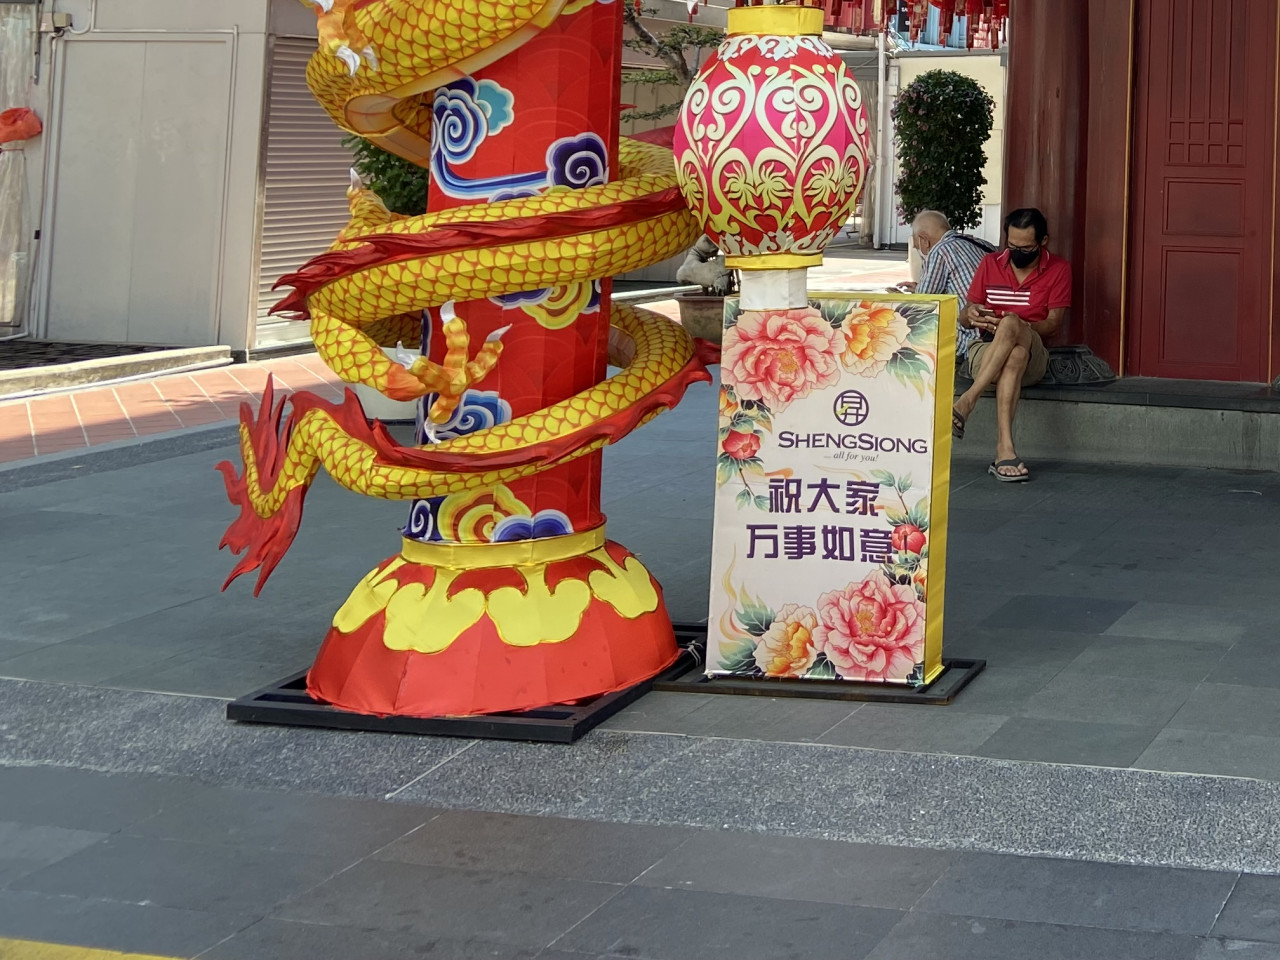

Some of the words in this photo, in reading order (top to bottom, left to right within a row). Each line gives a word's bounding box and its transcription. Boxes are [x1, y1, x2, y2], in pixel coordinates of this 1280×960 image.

[833, 451, 845, 460] all
[845, 451, 859, 462] for
[860, 453, 880, 463] you!
[768, 477, 880, 517] 祝大家
